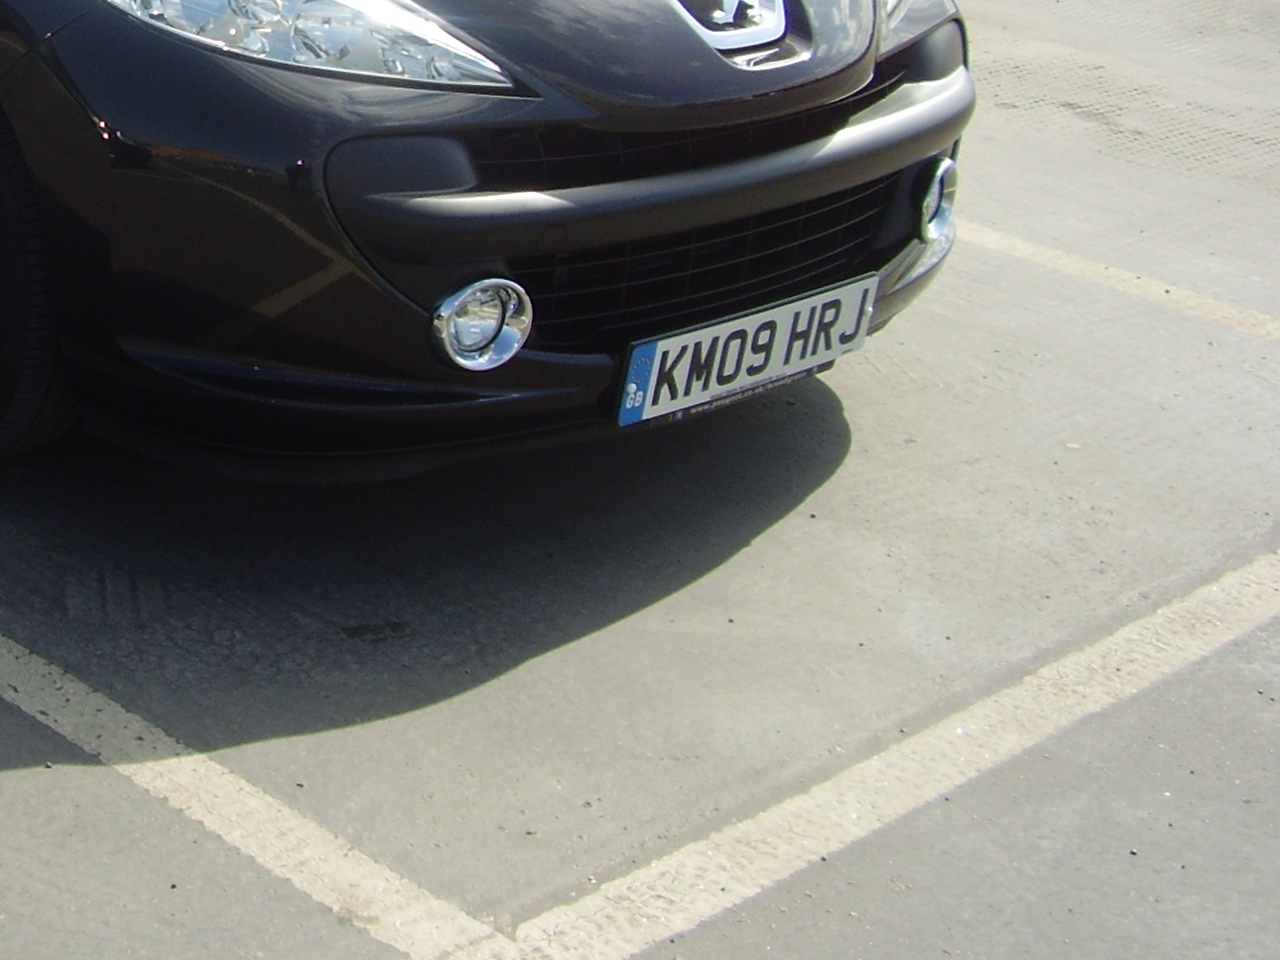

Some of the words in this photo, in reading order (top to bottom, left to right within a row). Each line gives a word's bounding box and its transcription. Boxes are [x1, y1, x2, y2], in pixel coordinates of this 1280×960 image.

[651, 320, 777, 406] KM09
[783, 288, 869, 366] HRJ
[625, 391, 643, 408] GB
